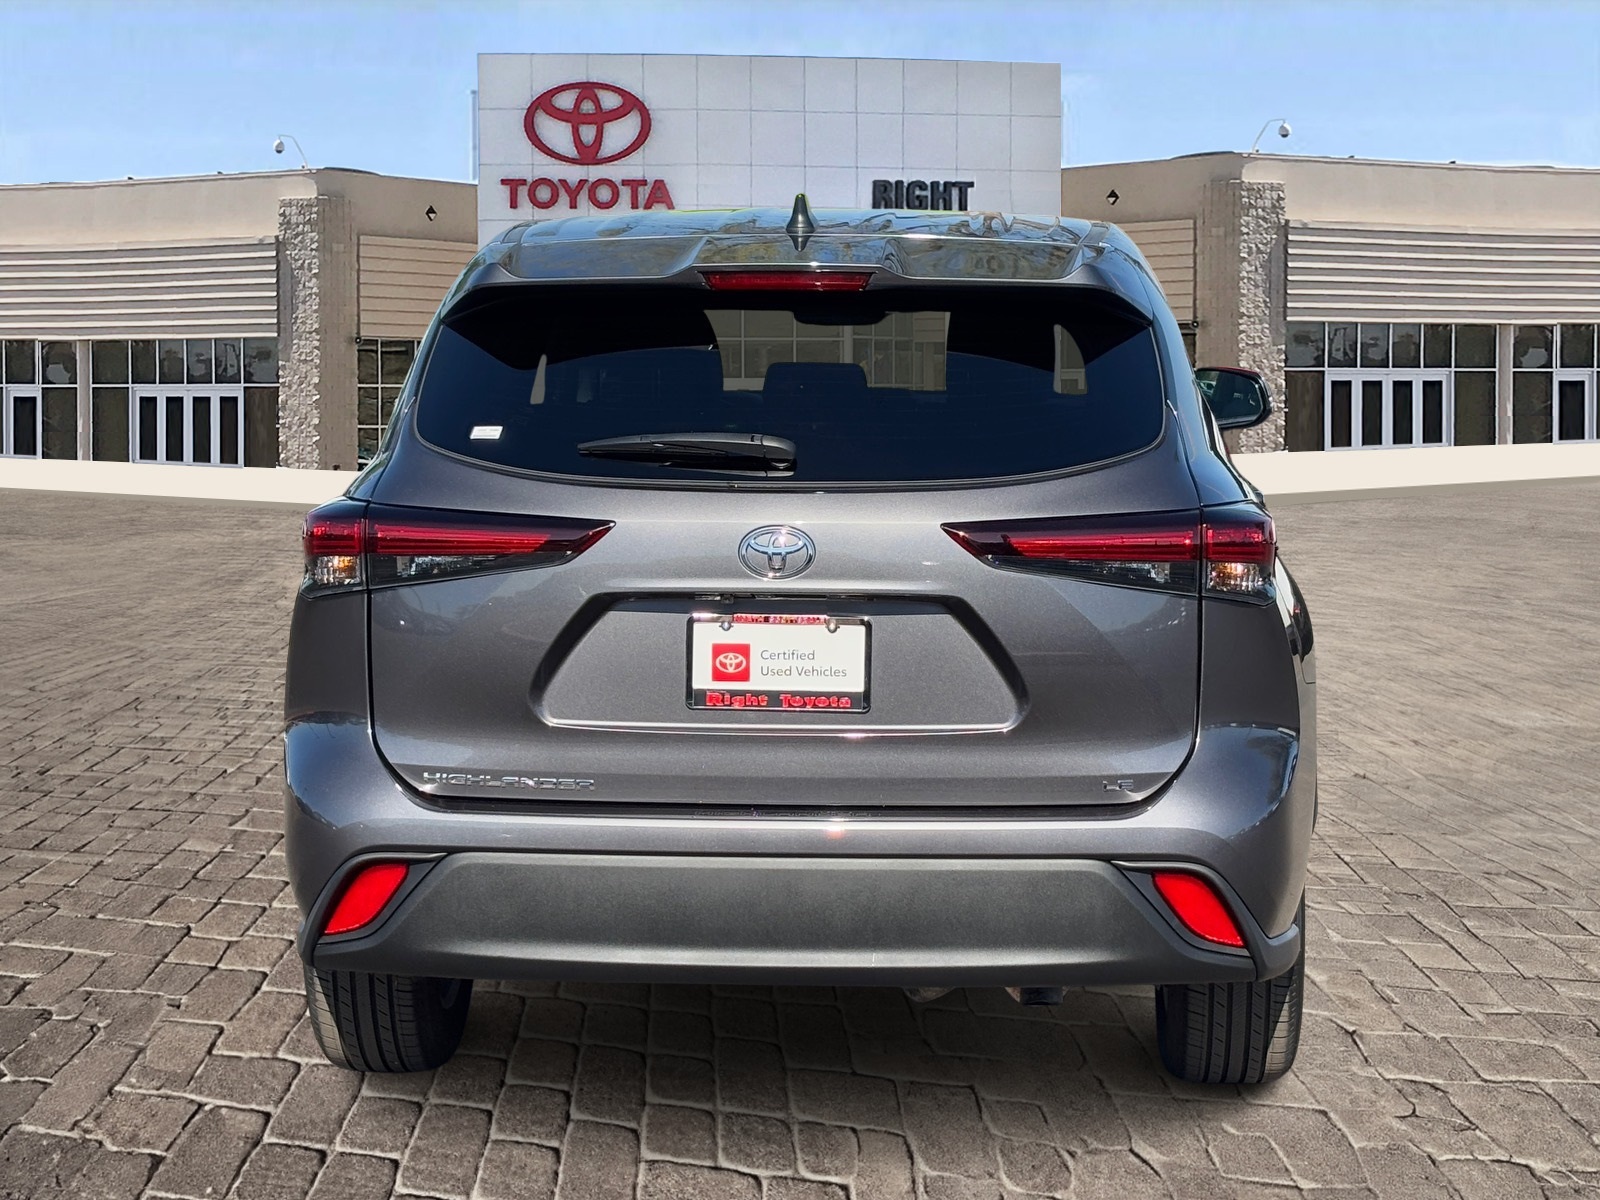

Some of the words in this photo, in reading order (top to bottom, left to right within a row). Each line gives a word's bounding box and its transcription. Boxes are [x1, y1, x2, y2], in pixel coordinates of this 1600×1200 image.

[500, 178, 675, 210] TOYOTA
[872, 179, 975, 211] RIGHT
[760, 650, 815, 661] Certified
[760, 666, 792, 677] Used
[796, 666, 847, 678] Vehicles
[706, 691, 768, 708] Right
[780, 693, 851, 709] Toyota
[423, 771, 595, 791] HIGHLANDER
[1102, 779, 1133, 791] LE
